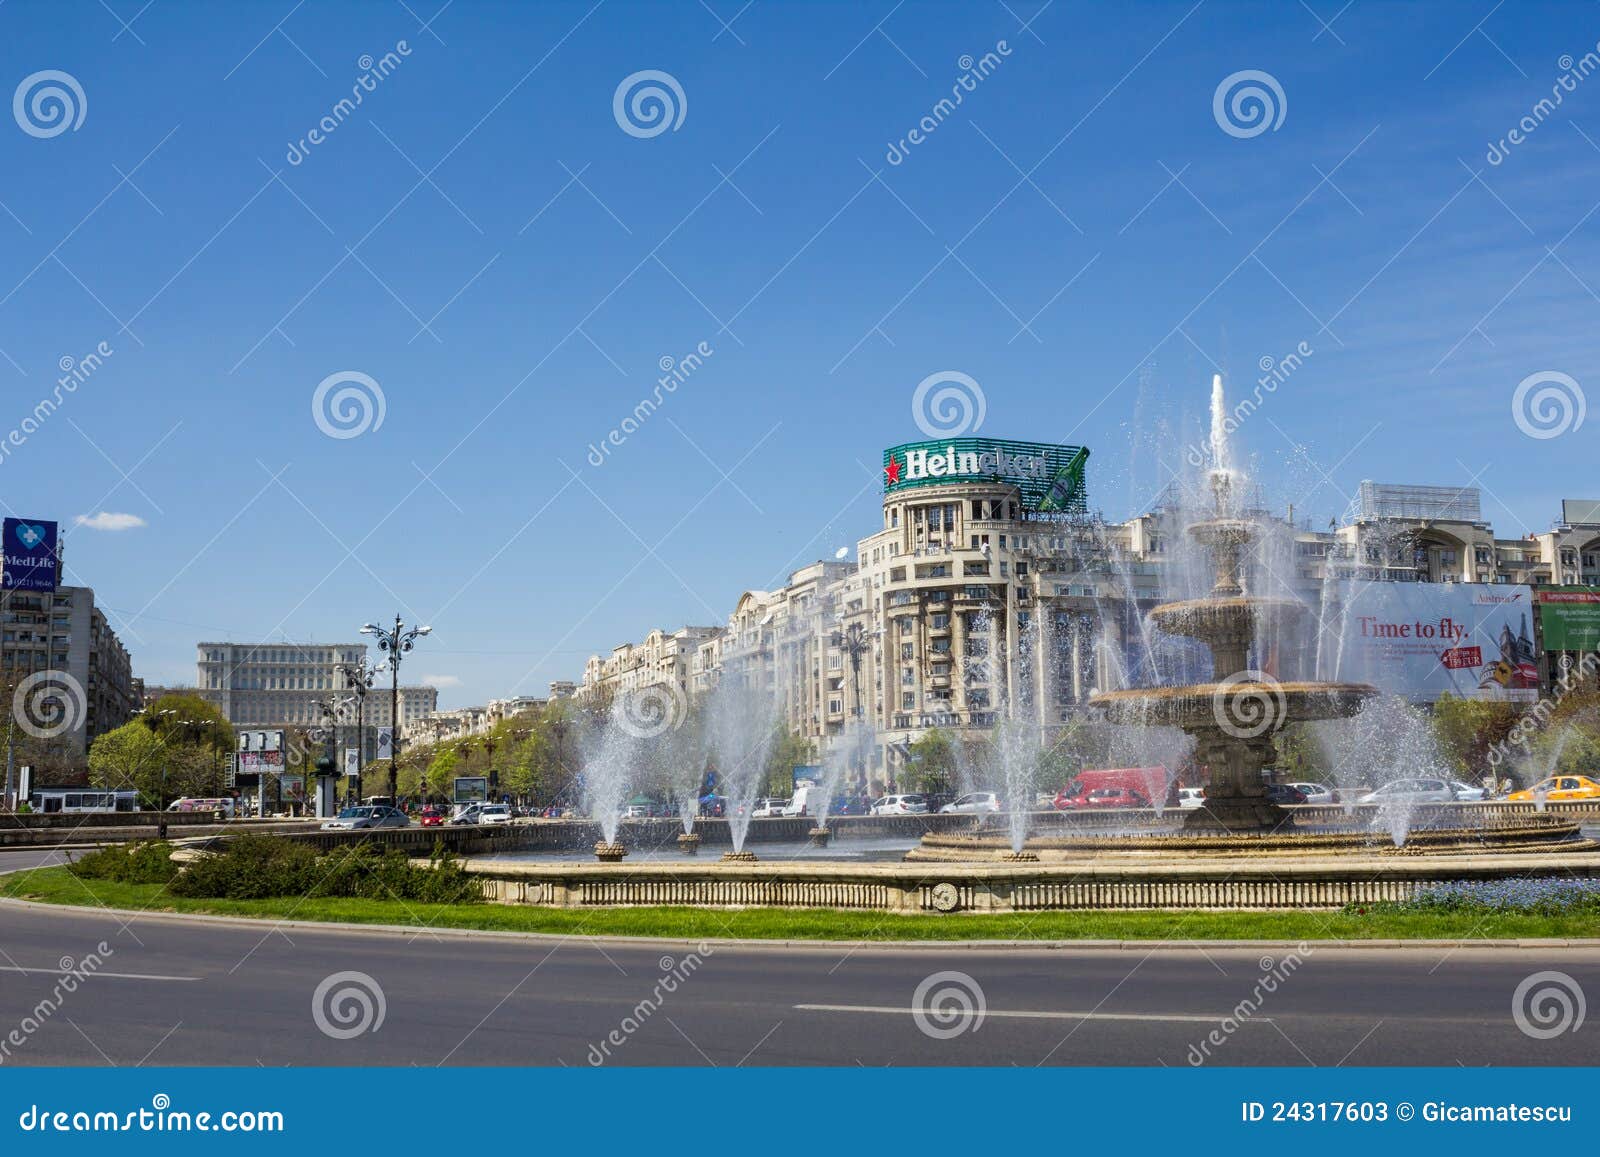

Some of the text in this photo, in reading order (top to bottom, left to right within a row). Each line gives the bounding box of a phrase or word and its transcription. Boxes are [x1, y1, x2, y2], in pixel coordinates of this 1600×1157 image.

[904, 446, 1048, 479] Heineken
[4, 555, 55, 568] MedLife
[1356, 616, 1469, 646] Time to fly.
